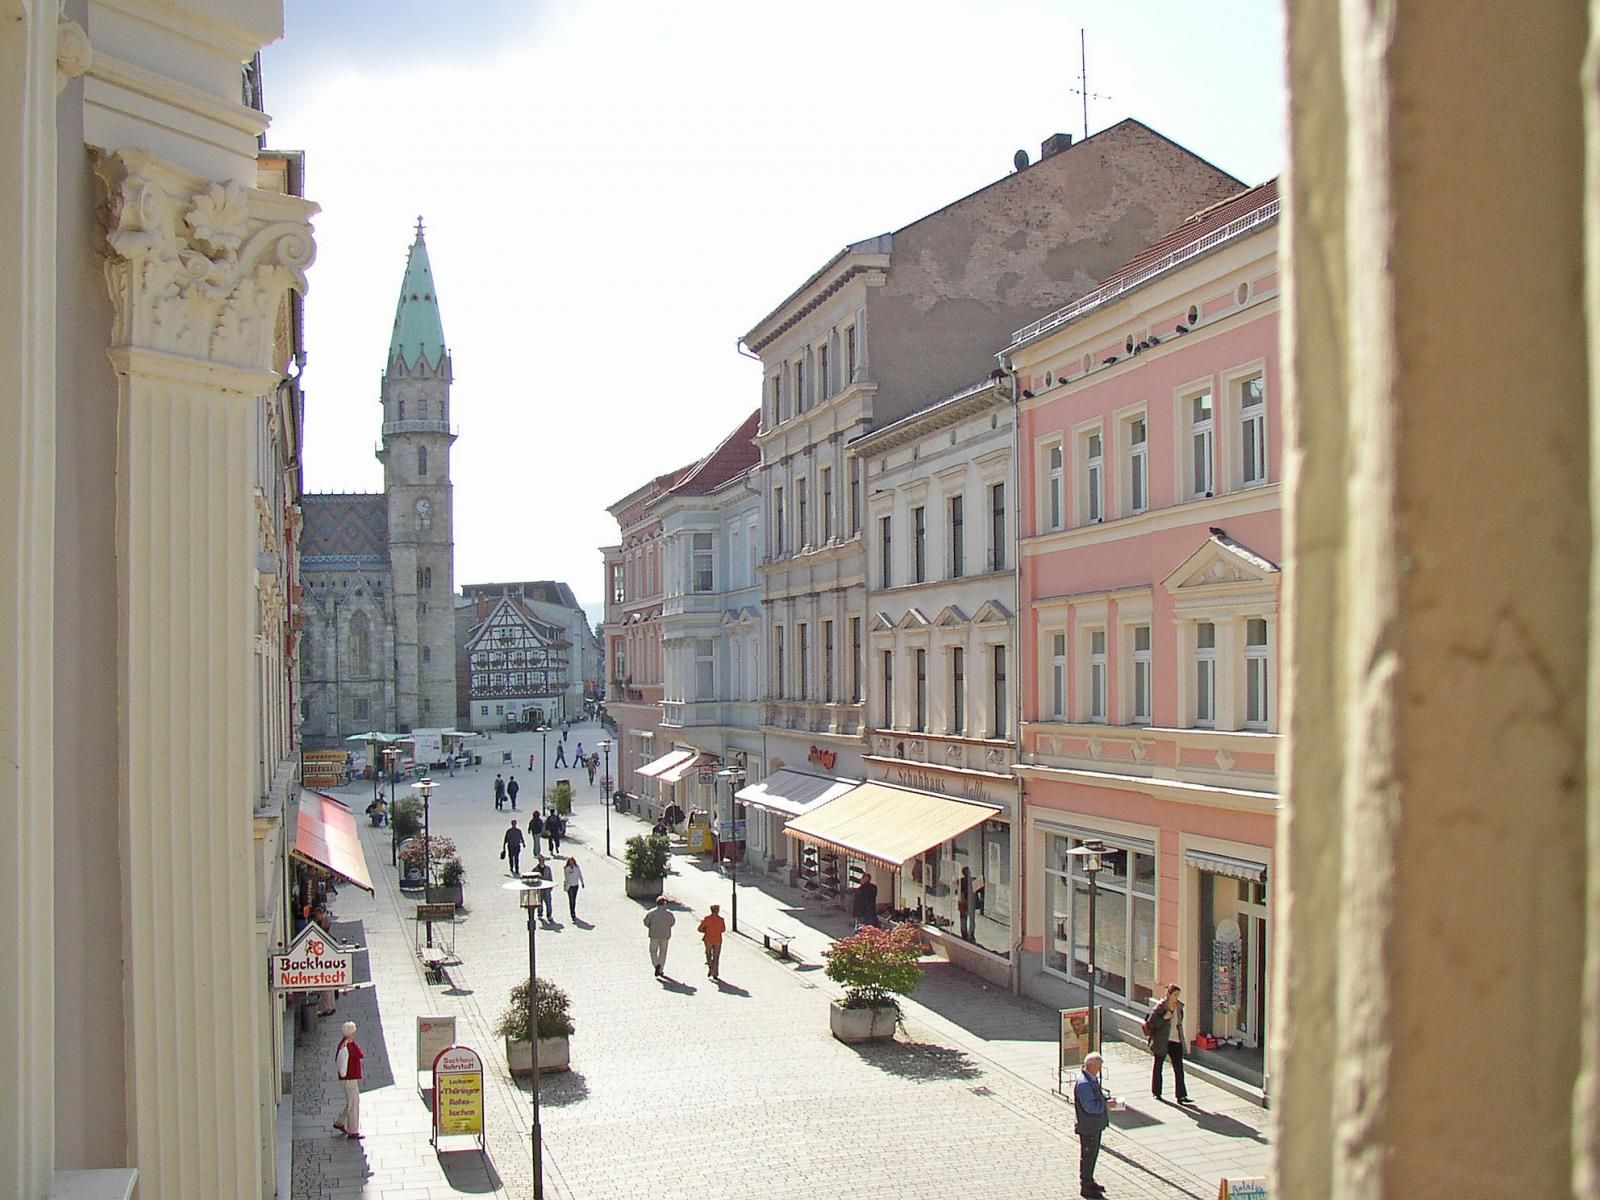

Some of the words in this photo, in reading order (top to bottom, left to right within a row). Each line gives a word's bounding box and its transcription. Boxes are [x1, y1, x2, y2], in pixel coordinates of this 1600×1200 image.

[898, 768, 946, 793] Schuhhaus
[280, 956, 347, 971] Backhaus
[280, 970, 347, 985] Nahrstedt
